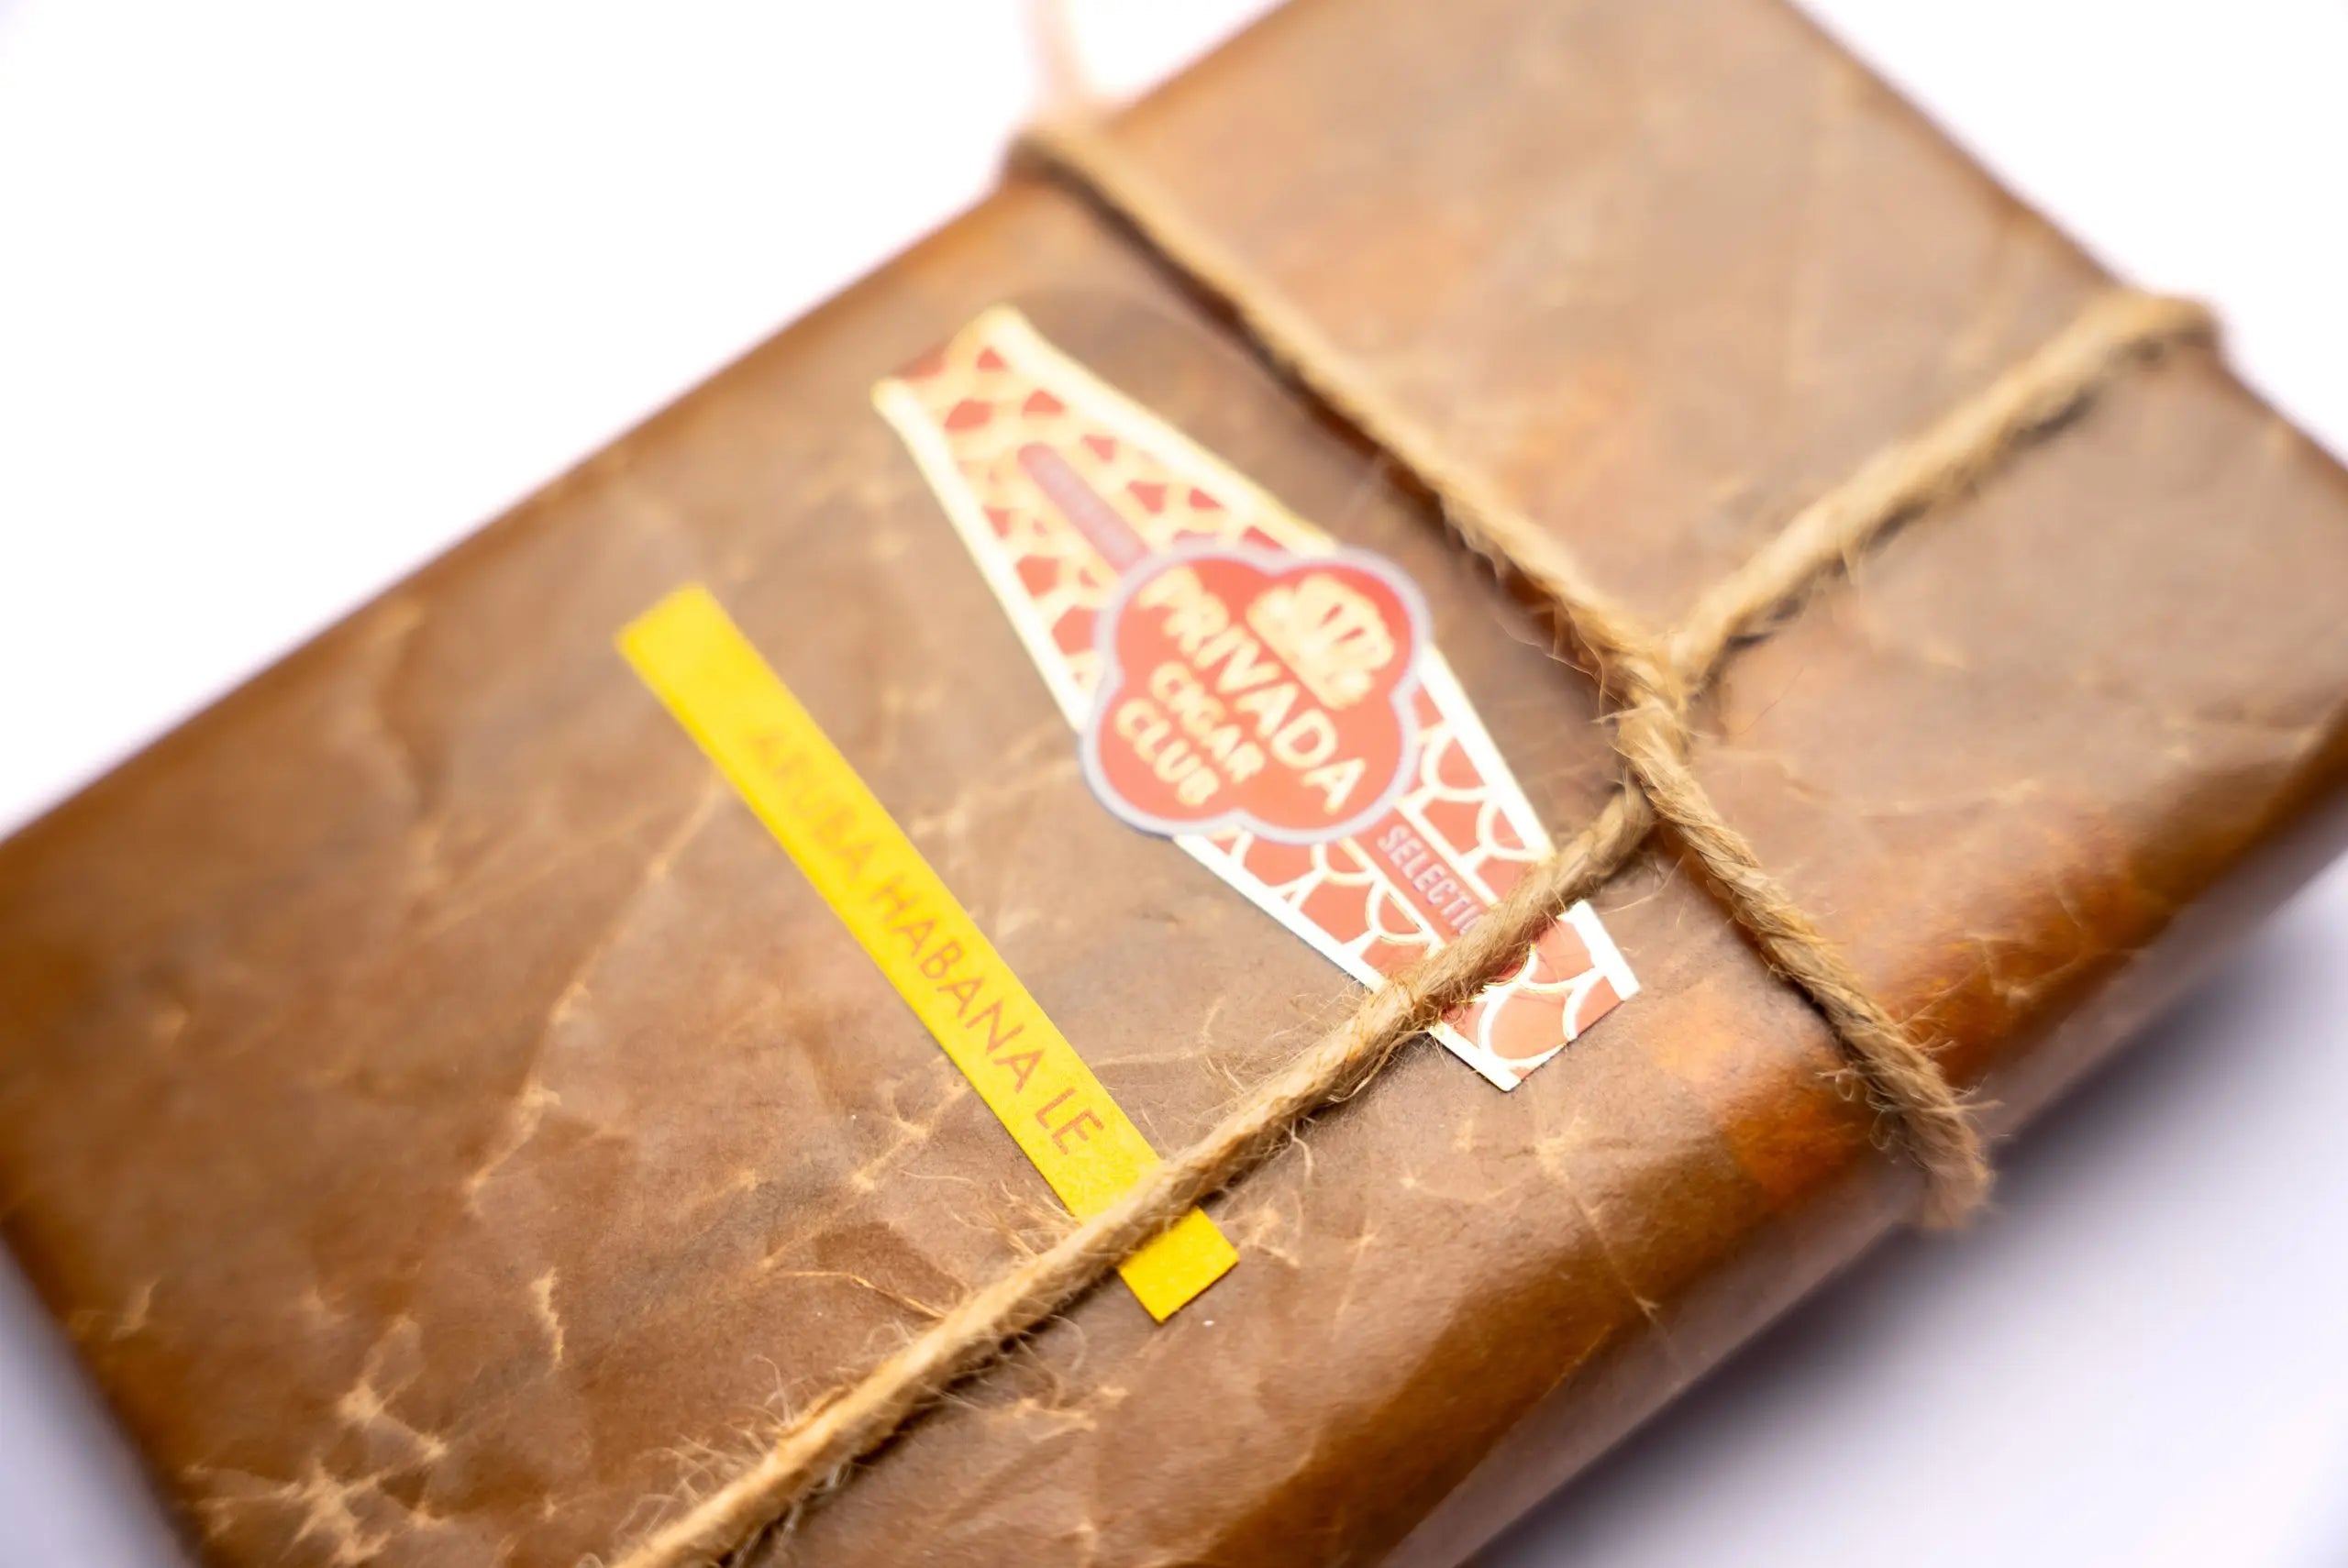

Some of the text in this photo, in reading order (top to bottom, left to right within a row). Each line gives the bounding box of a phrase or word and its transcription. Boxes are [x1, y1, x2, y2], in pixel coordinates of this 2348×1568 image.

[1116, 699, 1220, 807] CLUB
[1138, 567, 1365, 813] PRIVADA
[1151, 661, 1265, 783] CIGAR
[750, 730, 1105, 1155] ARUBA HABANA LE
